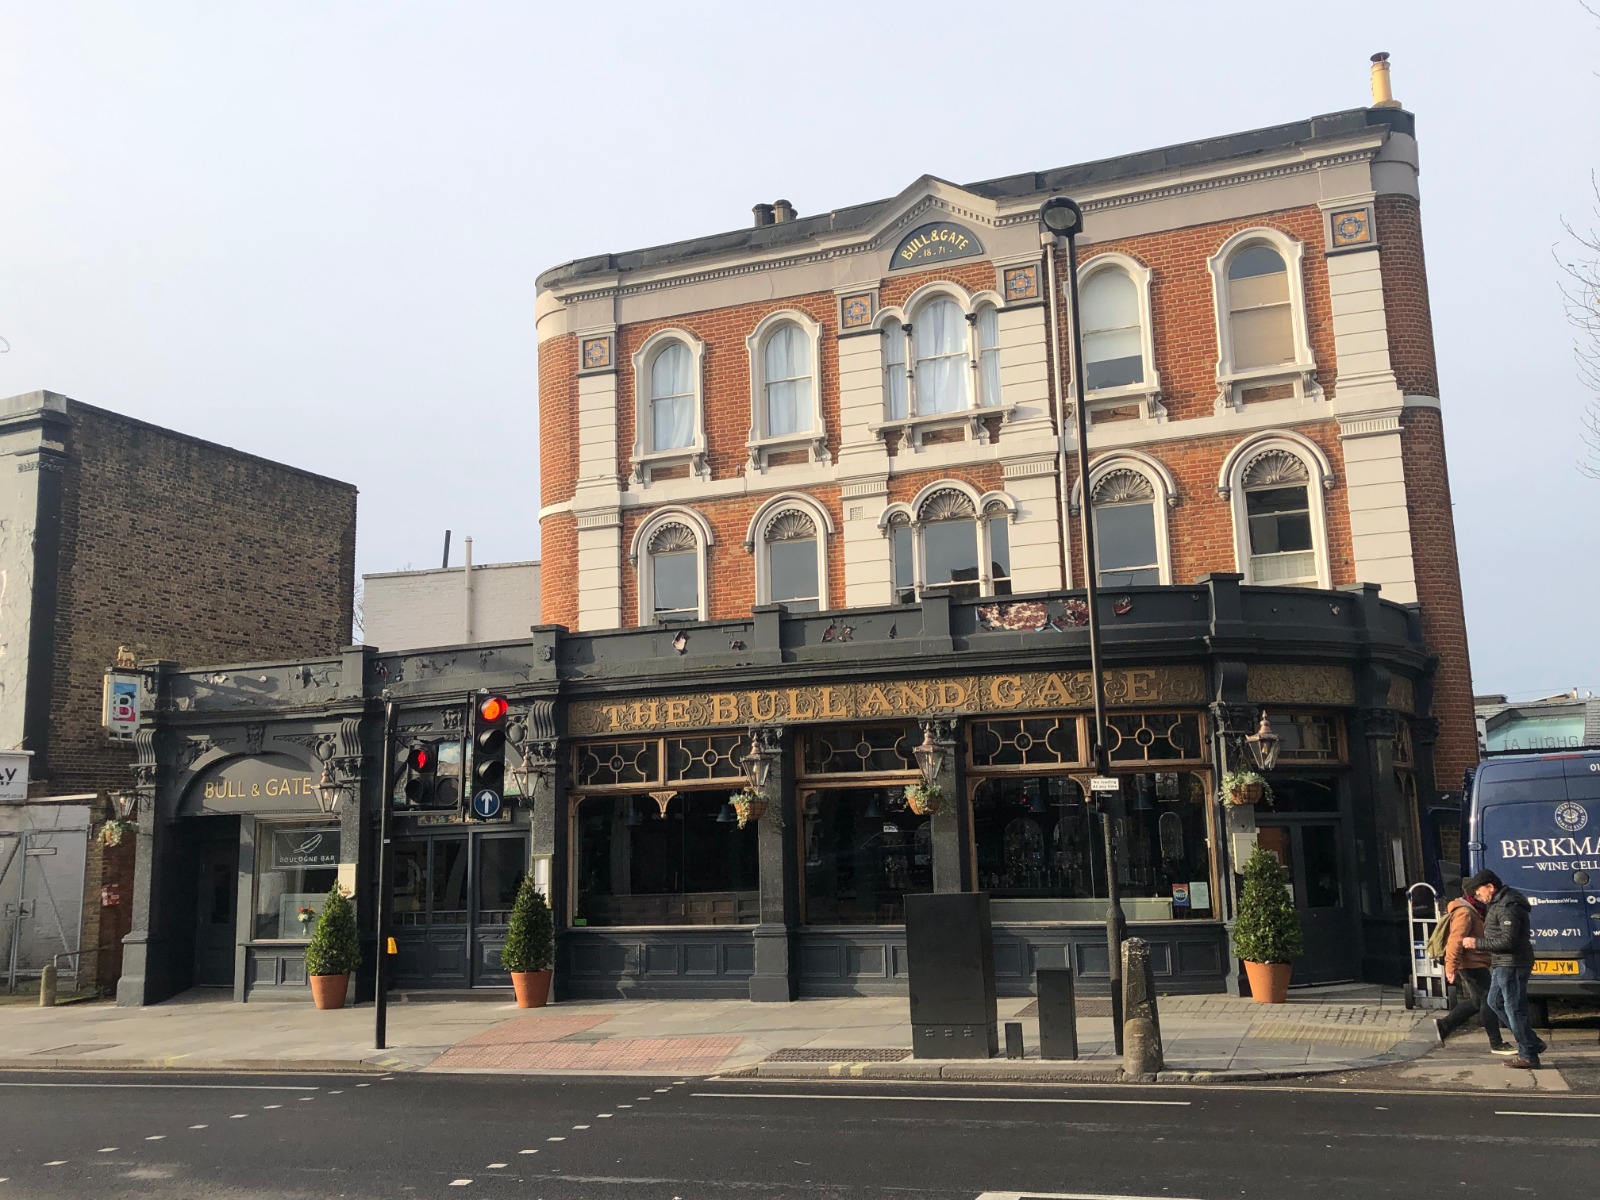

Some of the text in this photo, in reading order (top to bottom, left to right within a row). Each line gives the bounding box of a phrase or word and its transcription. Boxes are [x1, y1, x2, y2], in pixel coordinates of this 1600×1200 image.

[901, 229, 969, 260] BULL & GATE
[602, 700, 691, 727] THE
[710, 687, 847, 723] BULL
[861, 683, 967, 711] AND
[205, 777, 313, 799] BULL & GATE
[1536, 861, 1600, 871] WINE CELL
[1537, 929, 1559, 937] 7609
[1561, 928, 1582, 937] 4711
